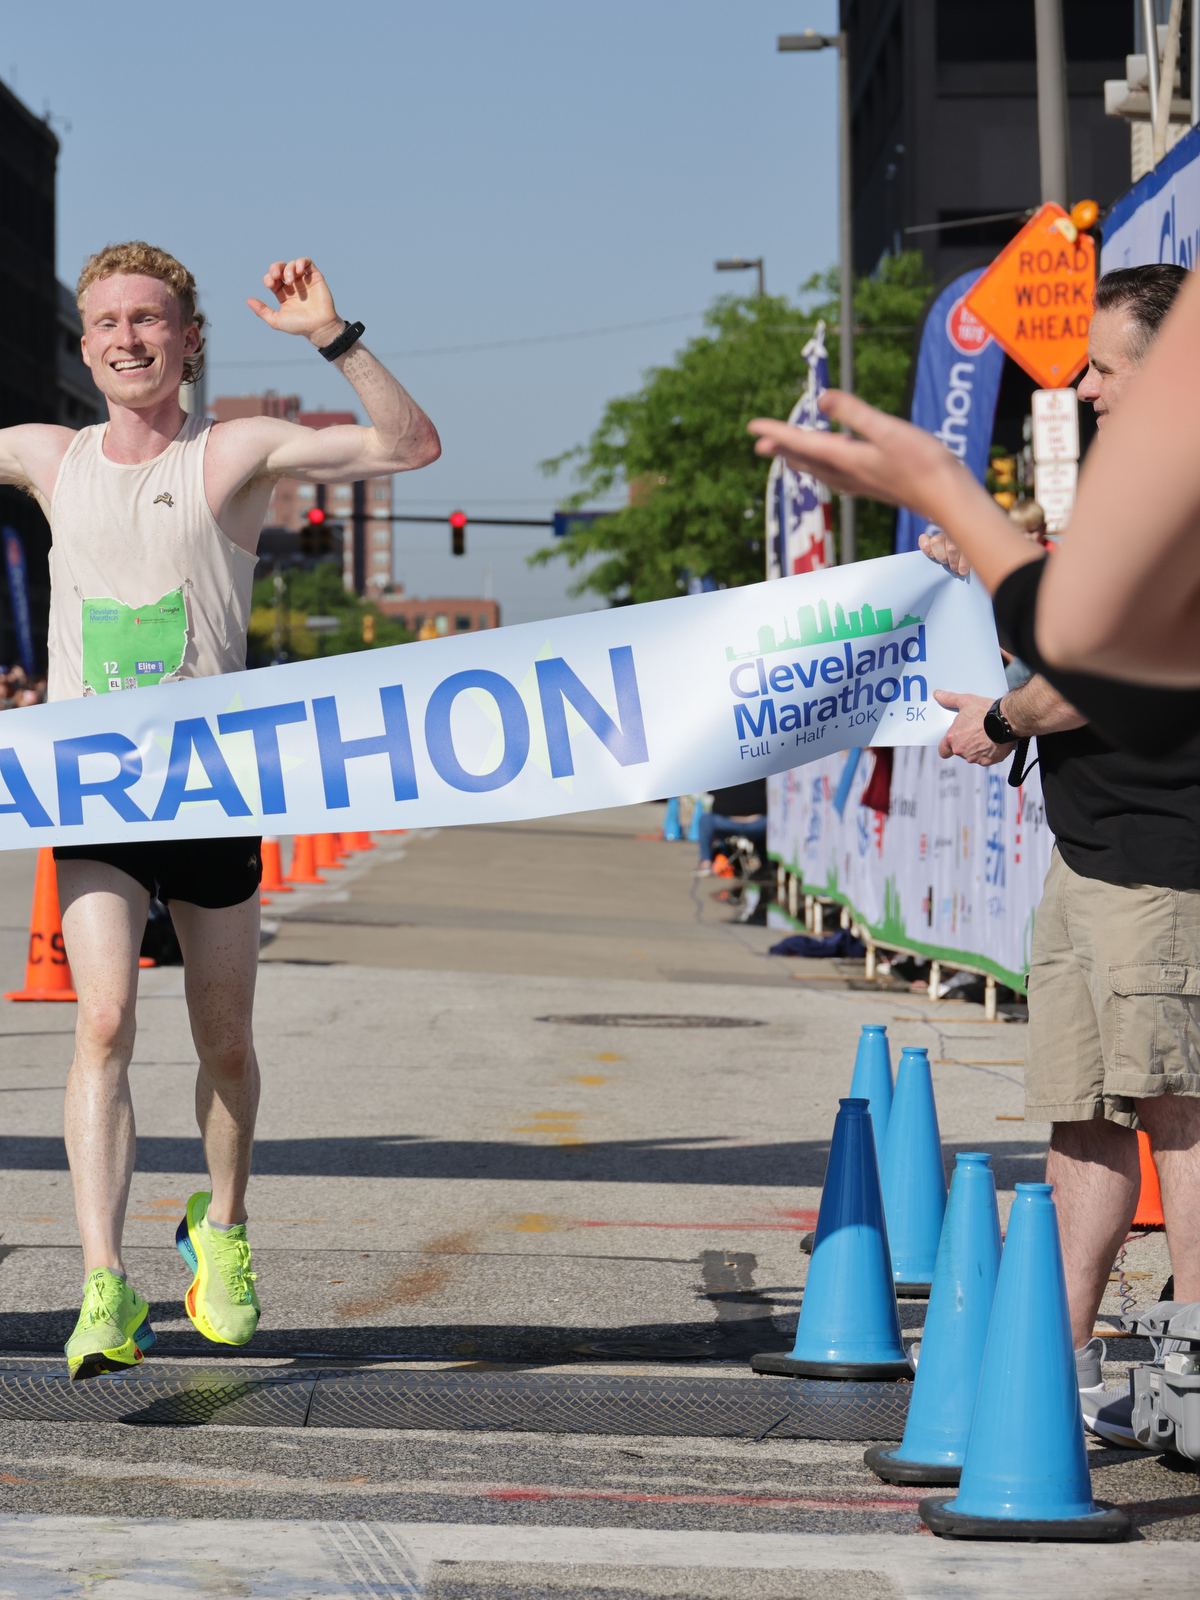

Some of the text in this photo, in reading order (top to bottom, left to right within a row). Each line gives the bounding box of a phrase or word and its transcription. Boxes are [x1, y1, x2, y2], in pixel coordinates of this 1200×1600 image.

[1019, 248, 1089, 275] ROAD
[1015, 280, 1087, 307] WORK
[1015, 314, 1091, 342] AHEAD
[103, 661, 119, 674] 12
[138, 662, 156, 670] Elite
[729, 624, 927, 699] Cleveland
[110, 680, 120, 688] EL
[732, 674, 928, 741] Marathon
[739, 707, 926, 760] Full Half 10K 5K
[30, 932, 68, 965] CS
